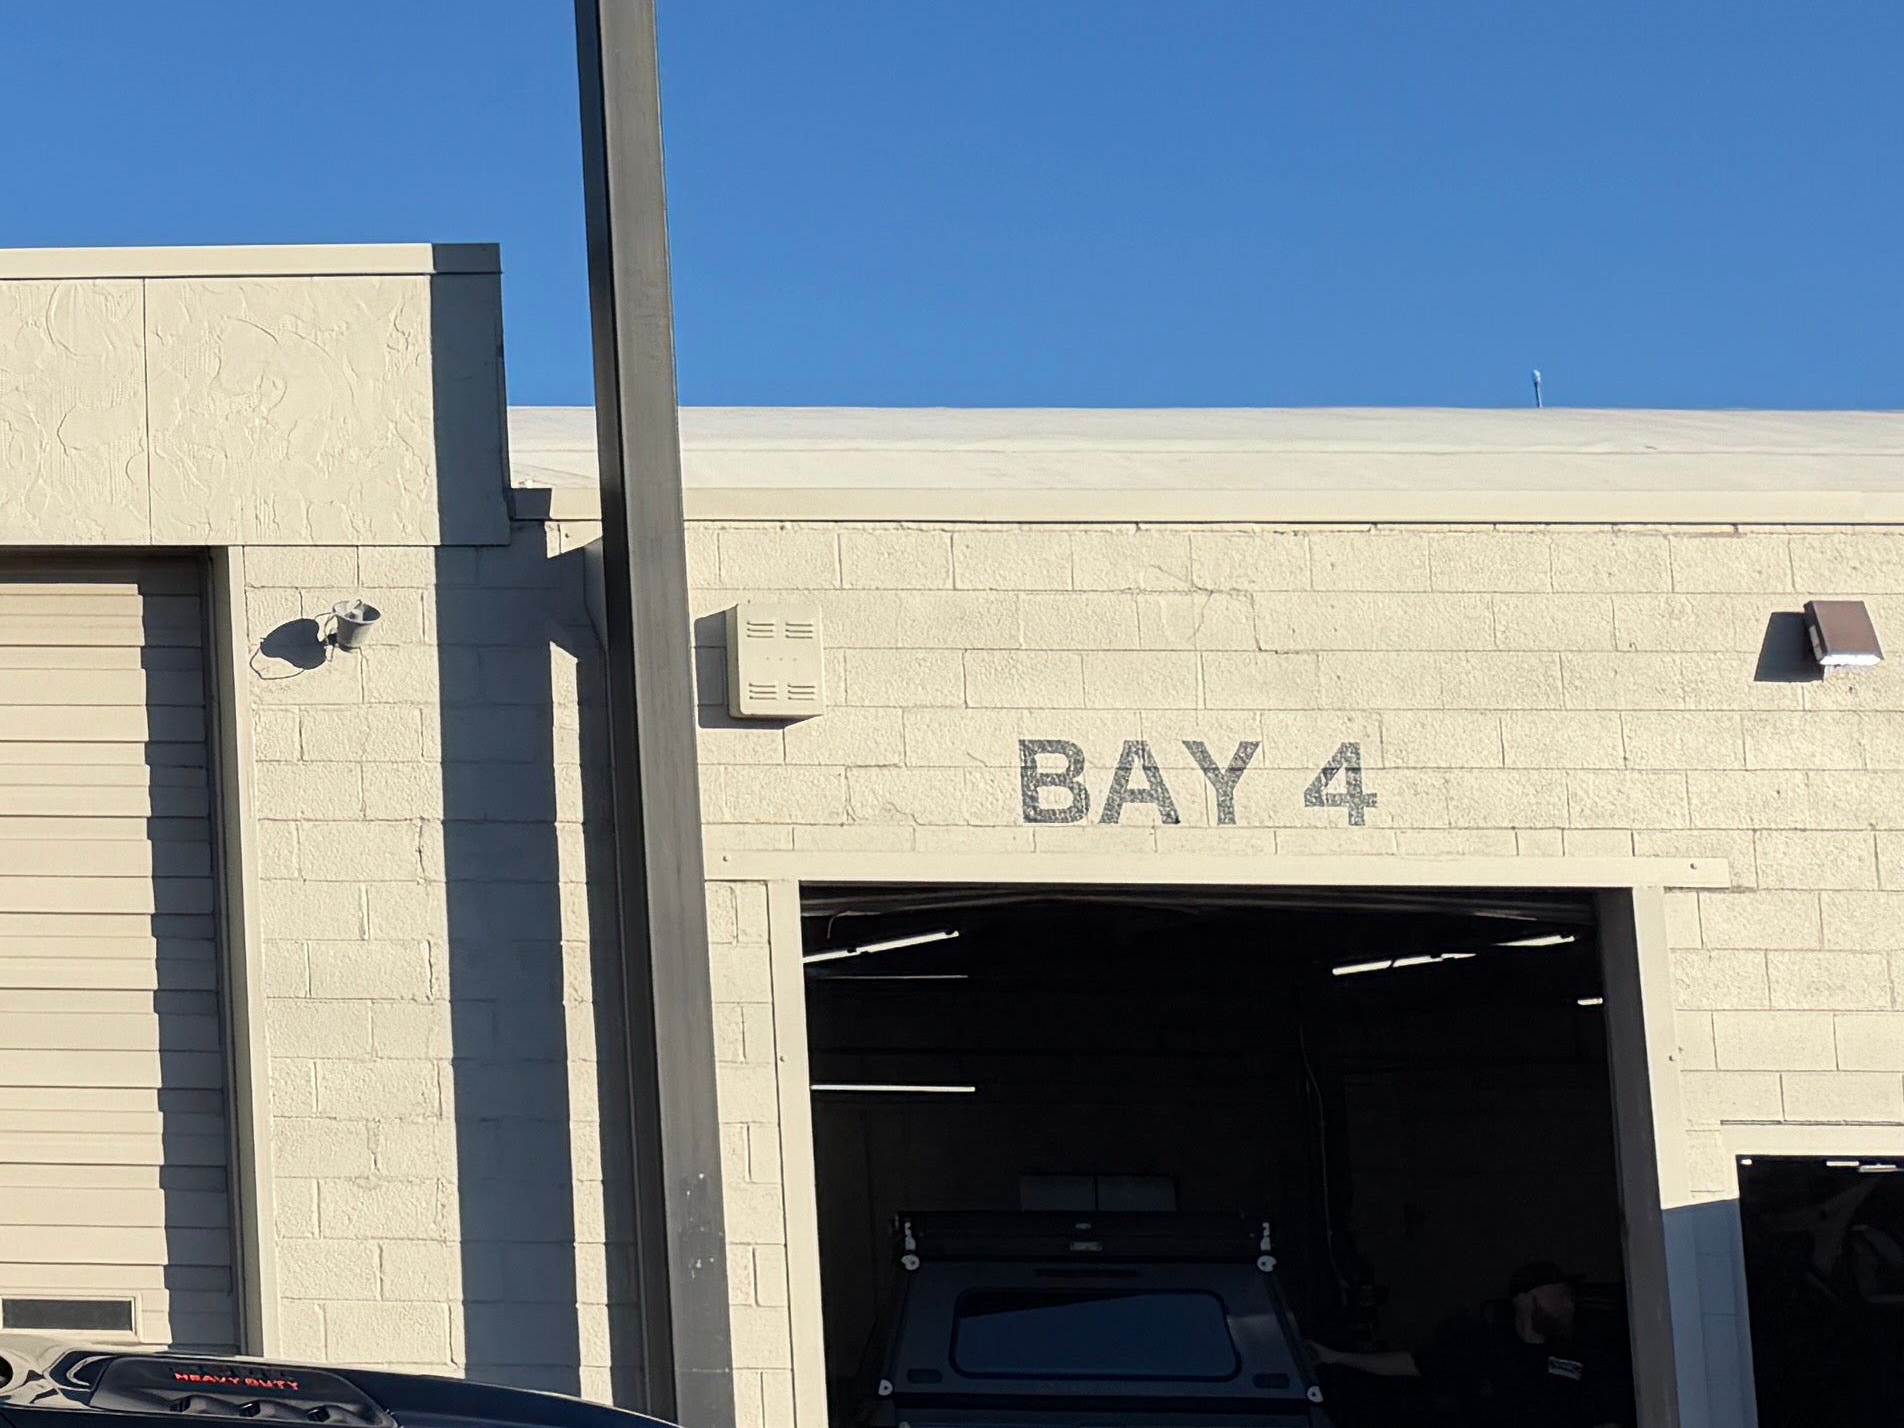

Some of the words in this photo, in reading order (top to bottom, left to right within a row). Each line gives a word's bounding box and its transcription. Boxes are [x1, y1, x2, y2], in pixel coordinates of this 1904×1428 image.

[1018, 739, 1261, 825] BAY
[1303, 741, 1378, 827] 4
[173, 1372, 240, 1385] HEAVY
[244, 1376, 300, 1391] DUTY
